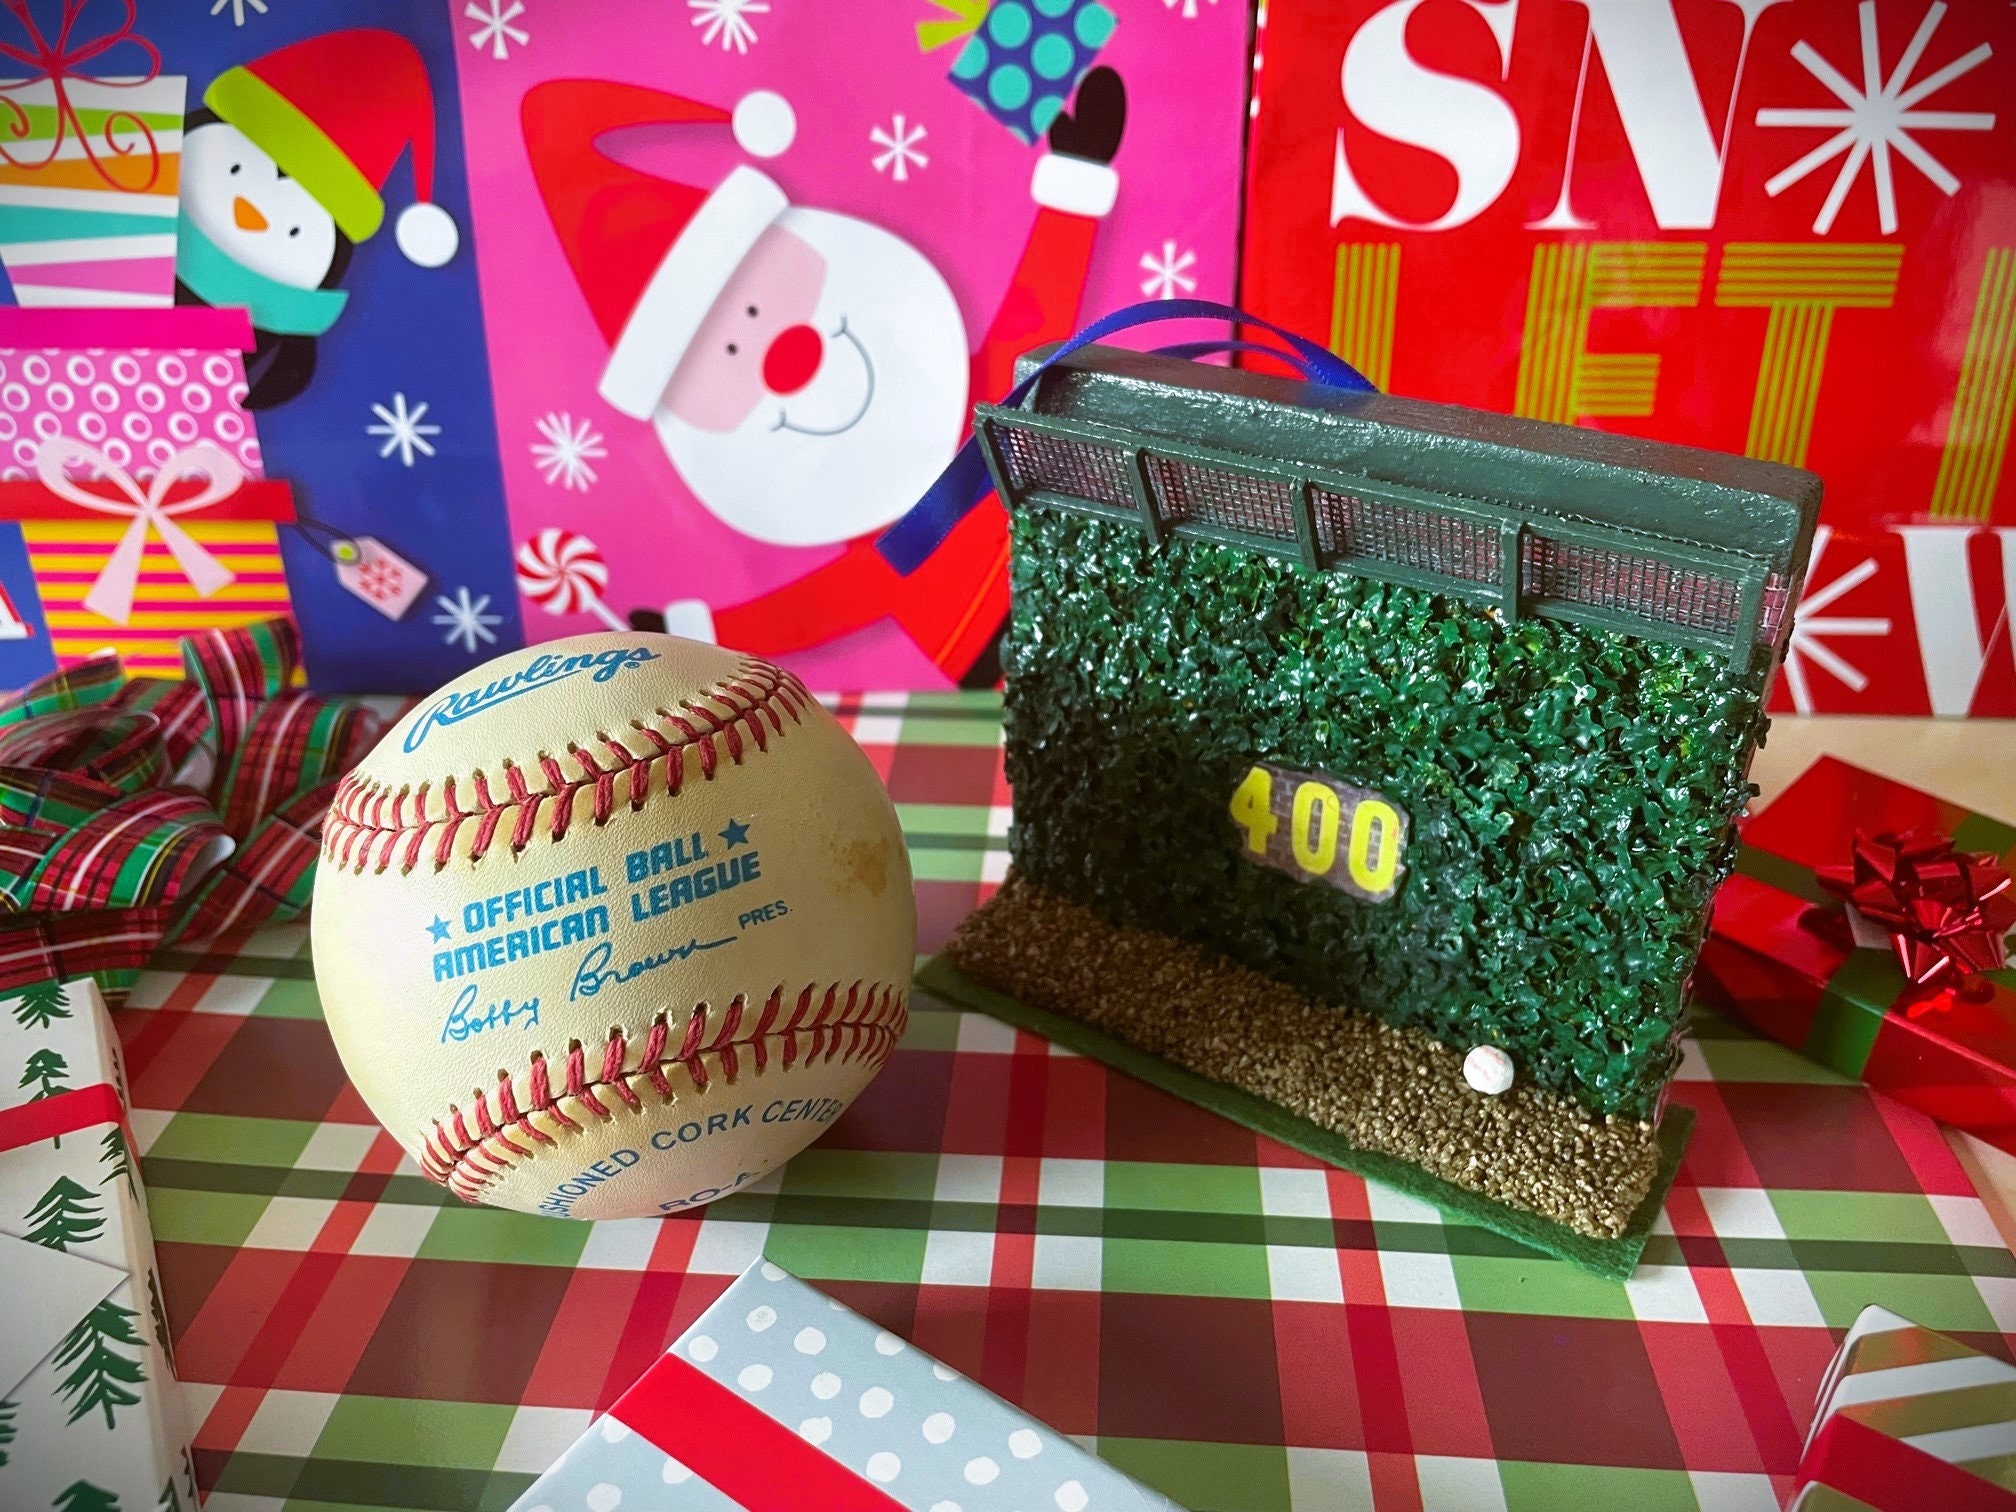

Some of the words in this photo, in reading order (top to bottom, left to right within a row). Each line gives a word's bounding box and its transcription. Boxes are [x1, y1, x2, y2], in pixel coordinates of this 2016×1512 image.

[1230, 766, 1399, 893] 400
[432, 904, 610, 982] AMERICAN
[630, 851, 761, 923] LEAGUE
[462, 865, 608, 934] OFFICIAL
[624, 831, 709, 884] BALL
[569, 935, 738, 1002] Brown
[737, 899, 794, 930] PRES.
[651, 1104, 754, 1151] CORK
[761, 1097, 844, 1125] CENTER
